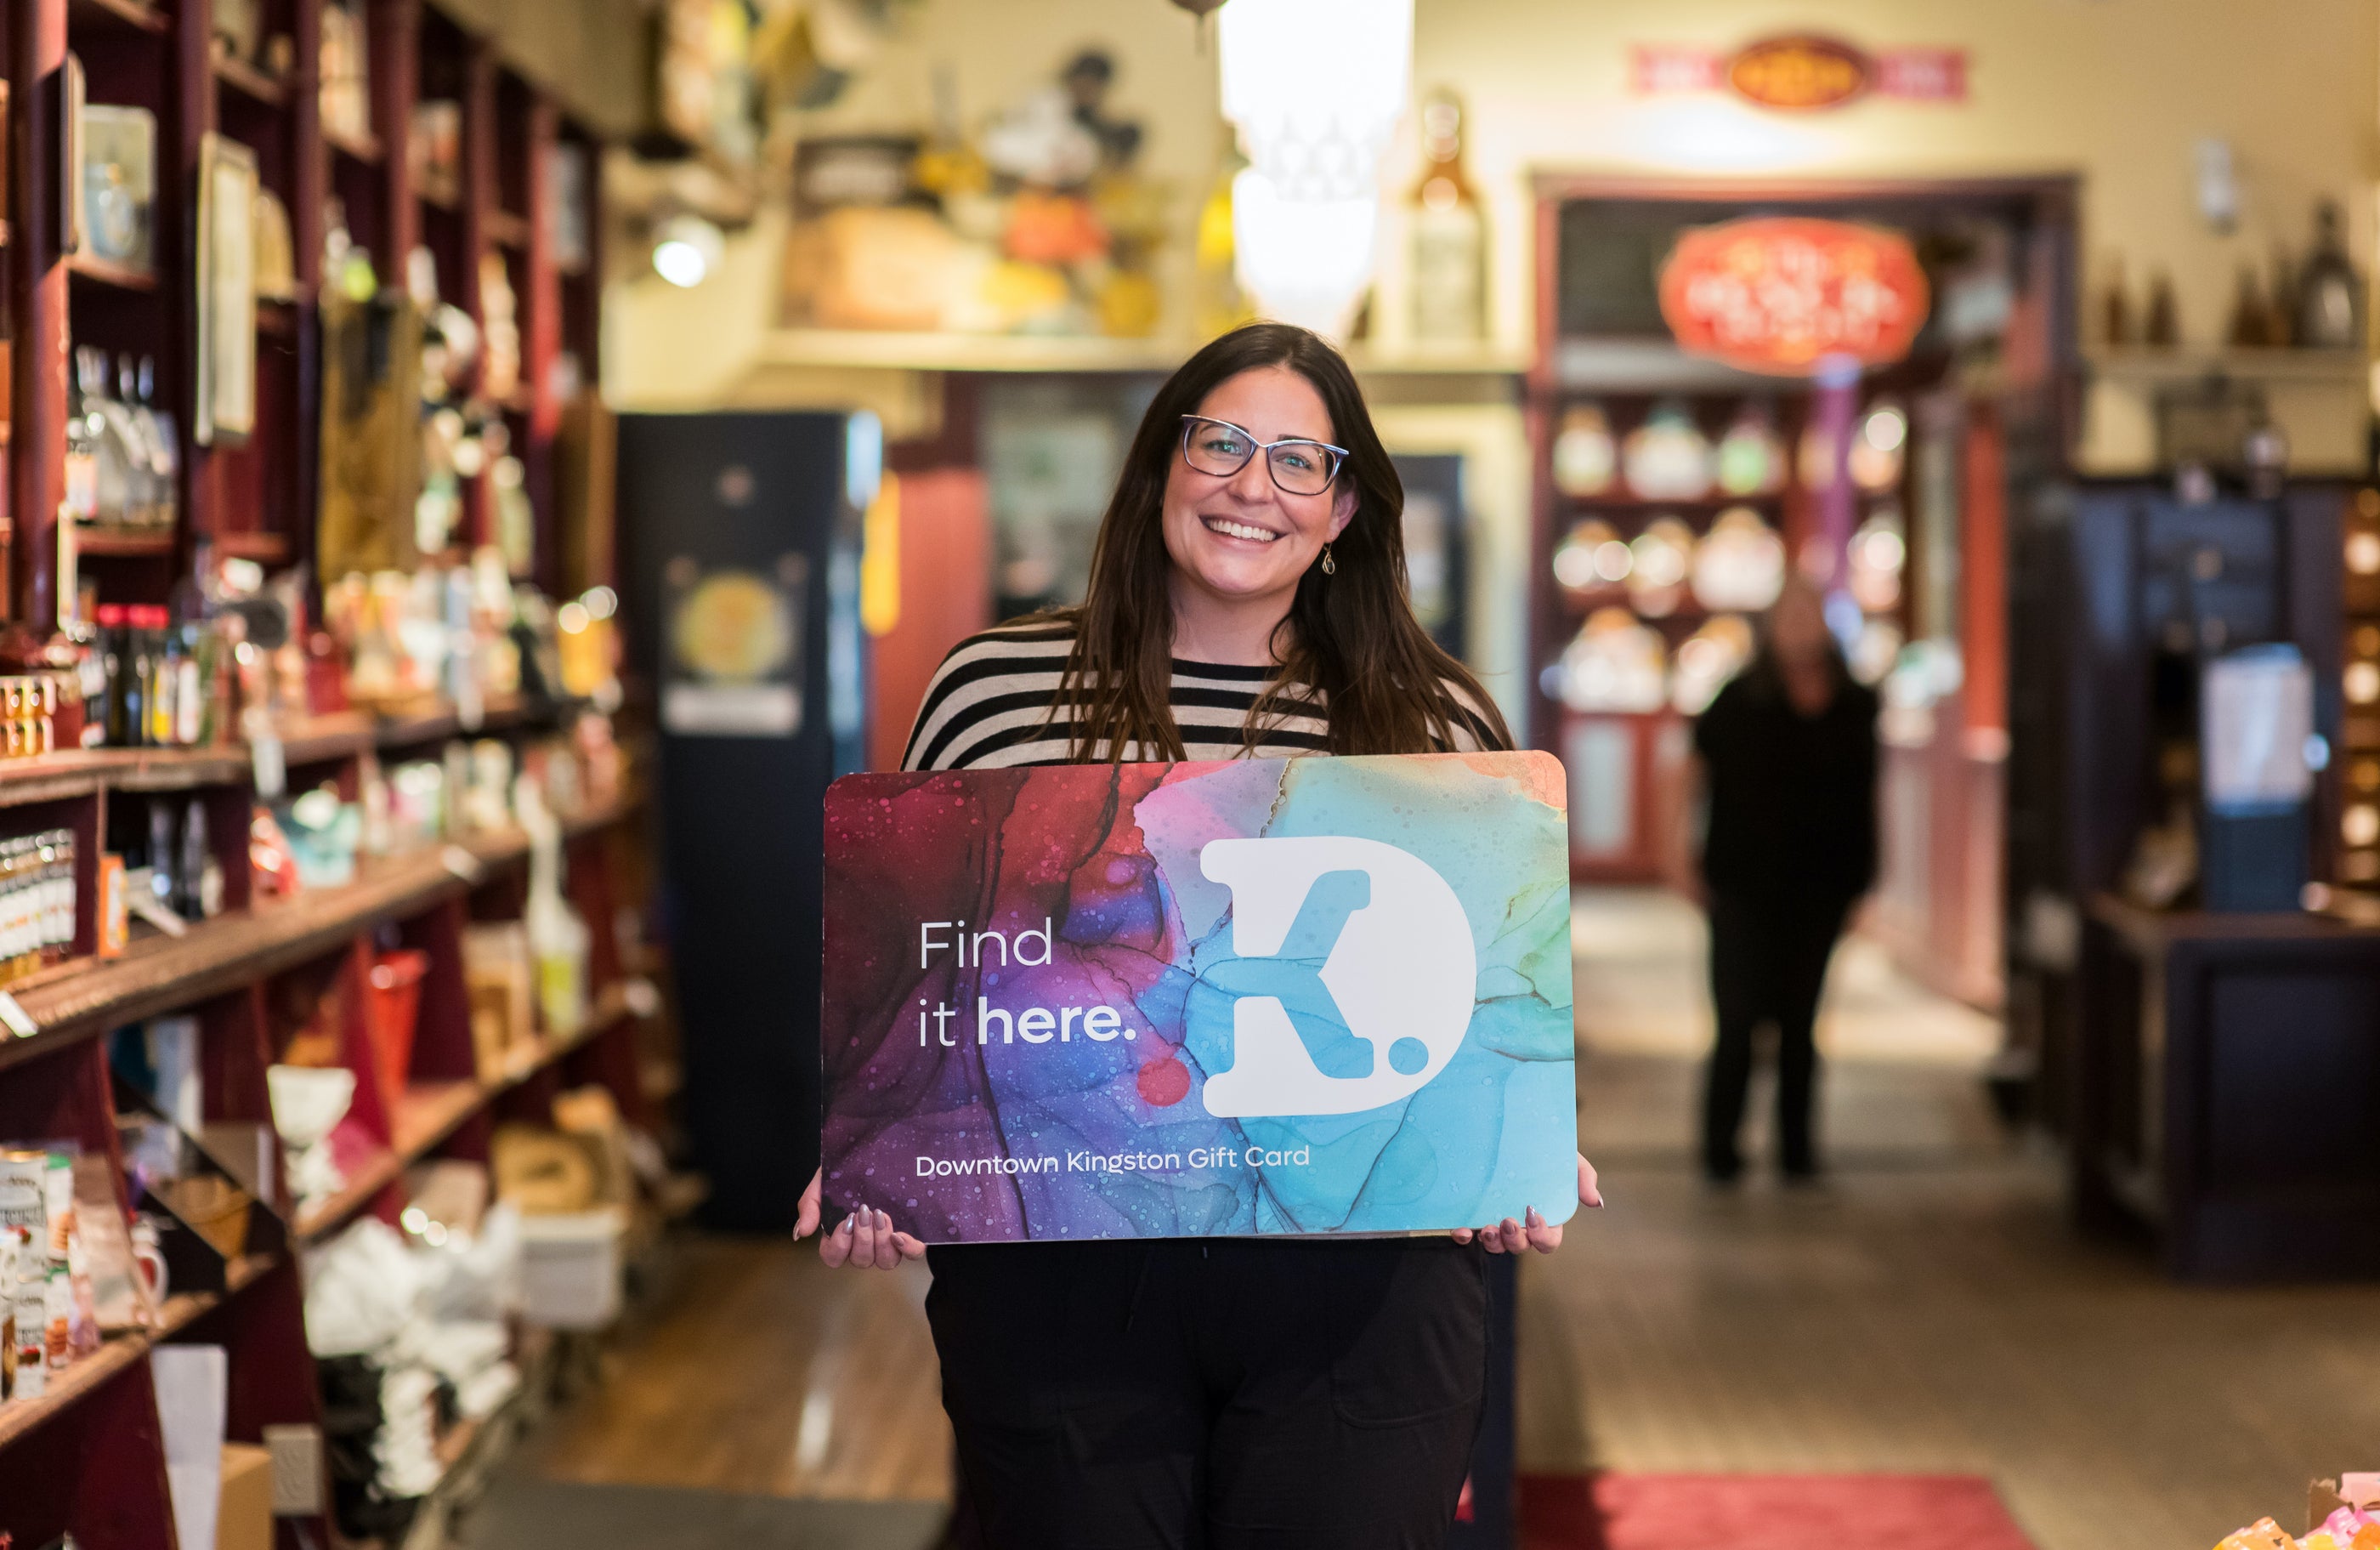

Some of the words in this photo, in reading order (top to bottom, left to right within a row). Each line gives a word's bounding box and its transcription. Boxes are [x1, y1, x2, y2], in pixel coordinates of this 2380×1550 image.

[921, 916, 1052, 969] Find
[920, 997, 956, 1048] it
[978, 995, 1137, 1045] here.
[915, 1155, 1059, 1178] Downtown
[1067, 1150, 1181, 1176] Kingston
[1187, 1146, 1238, 1169] Gift
[1244, 1144, 1311, 1167] Card
